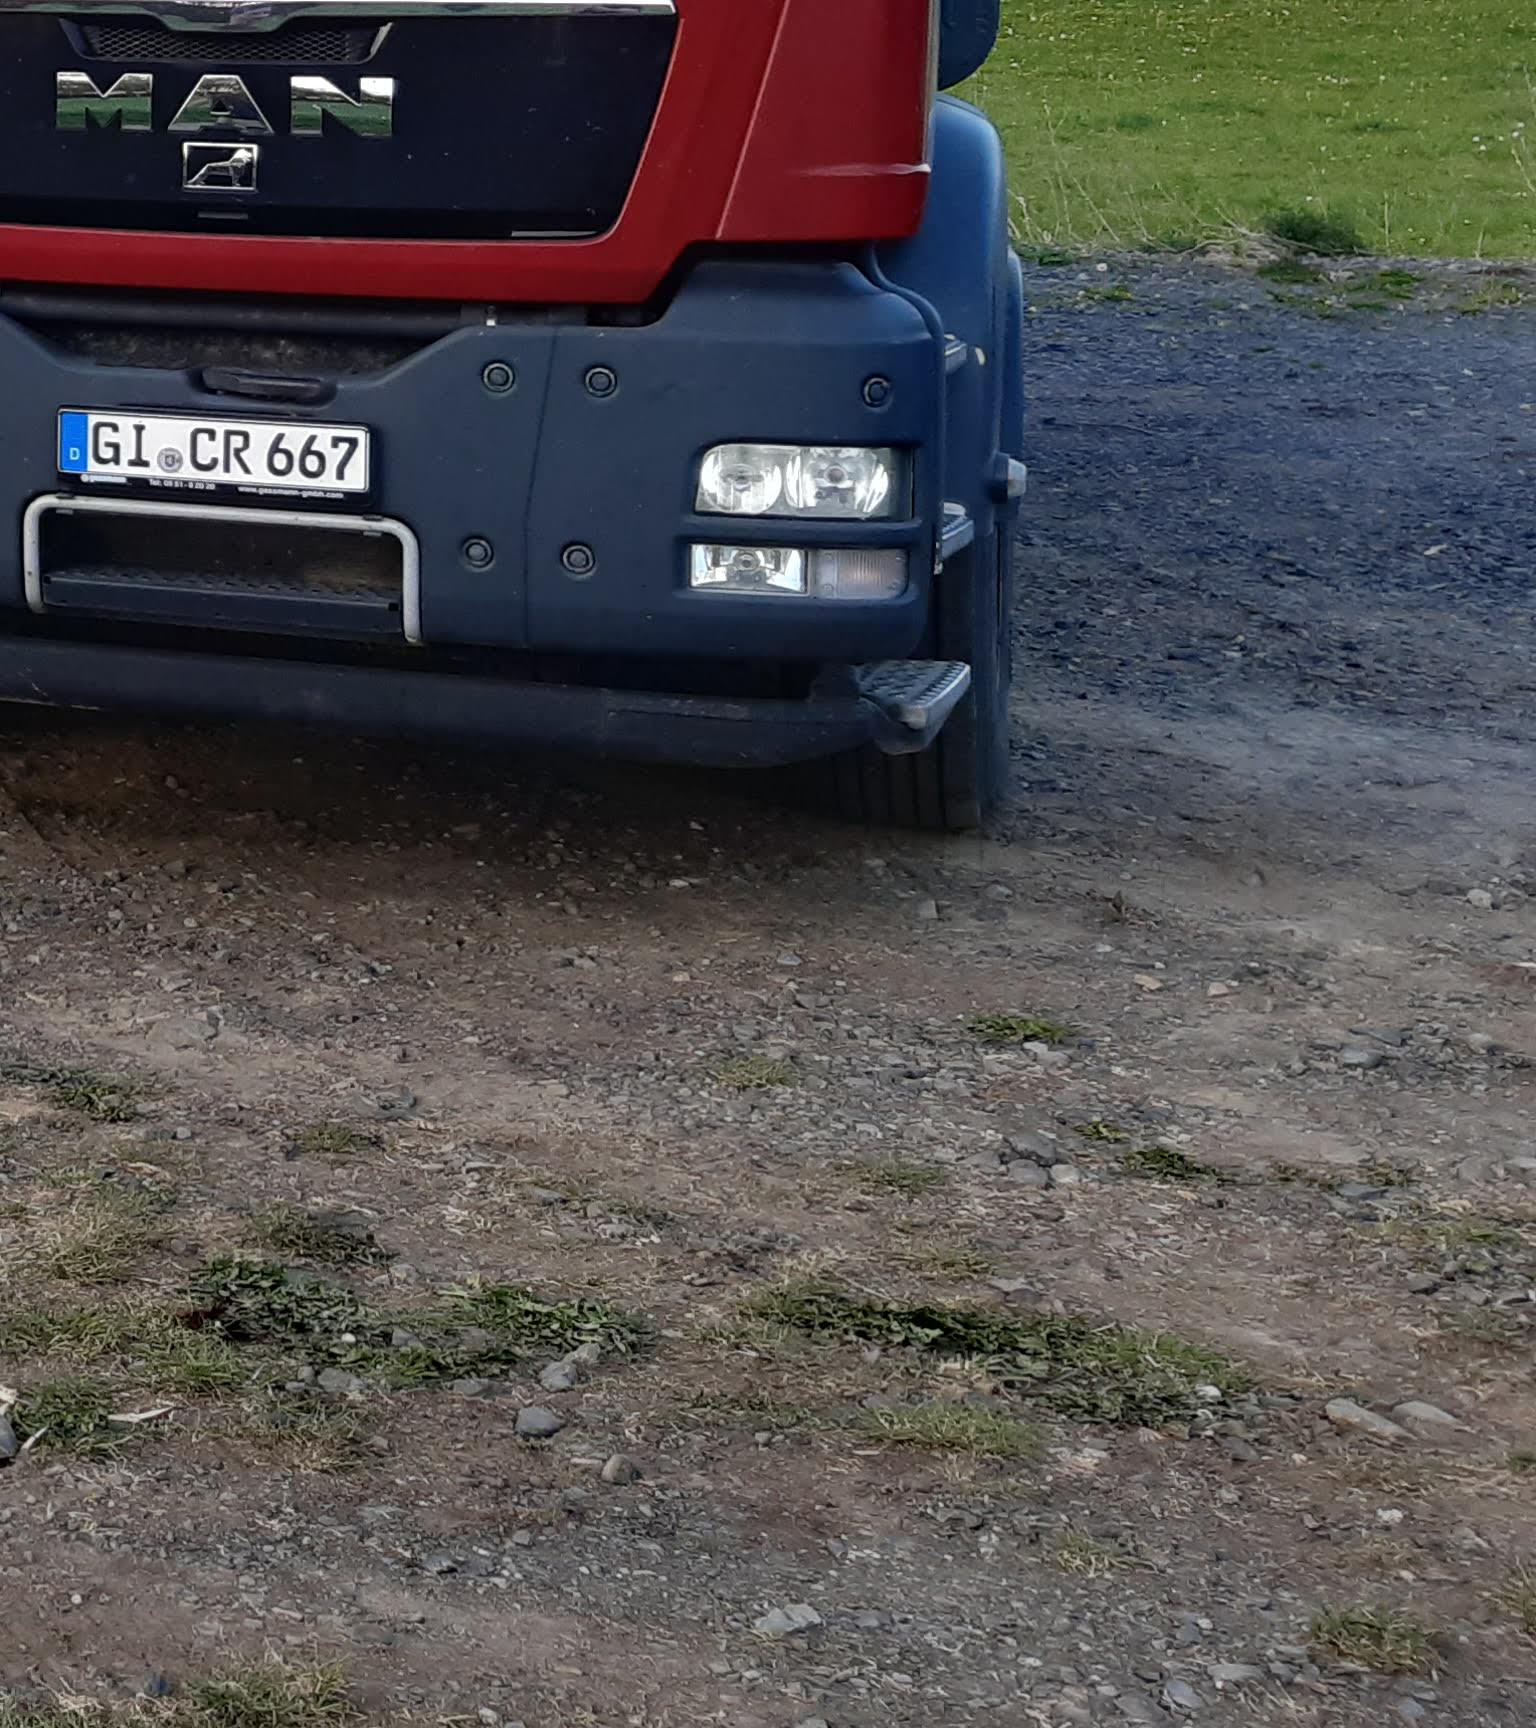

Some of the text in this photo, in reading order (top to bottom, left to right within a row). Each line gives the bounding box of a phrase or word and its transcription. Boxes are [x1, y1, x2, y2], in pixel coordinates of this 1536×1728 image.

[56, 72, 395, 136] MAN
[69, 447, 80, 460] D
[92, 421, 359, 481] GI CR 667
